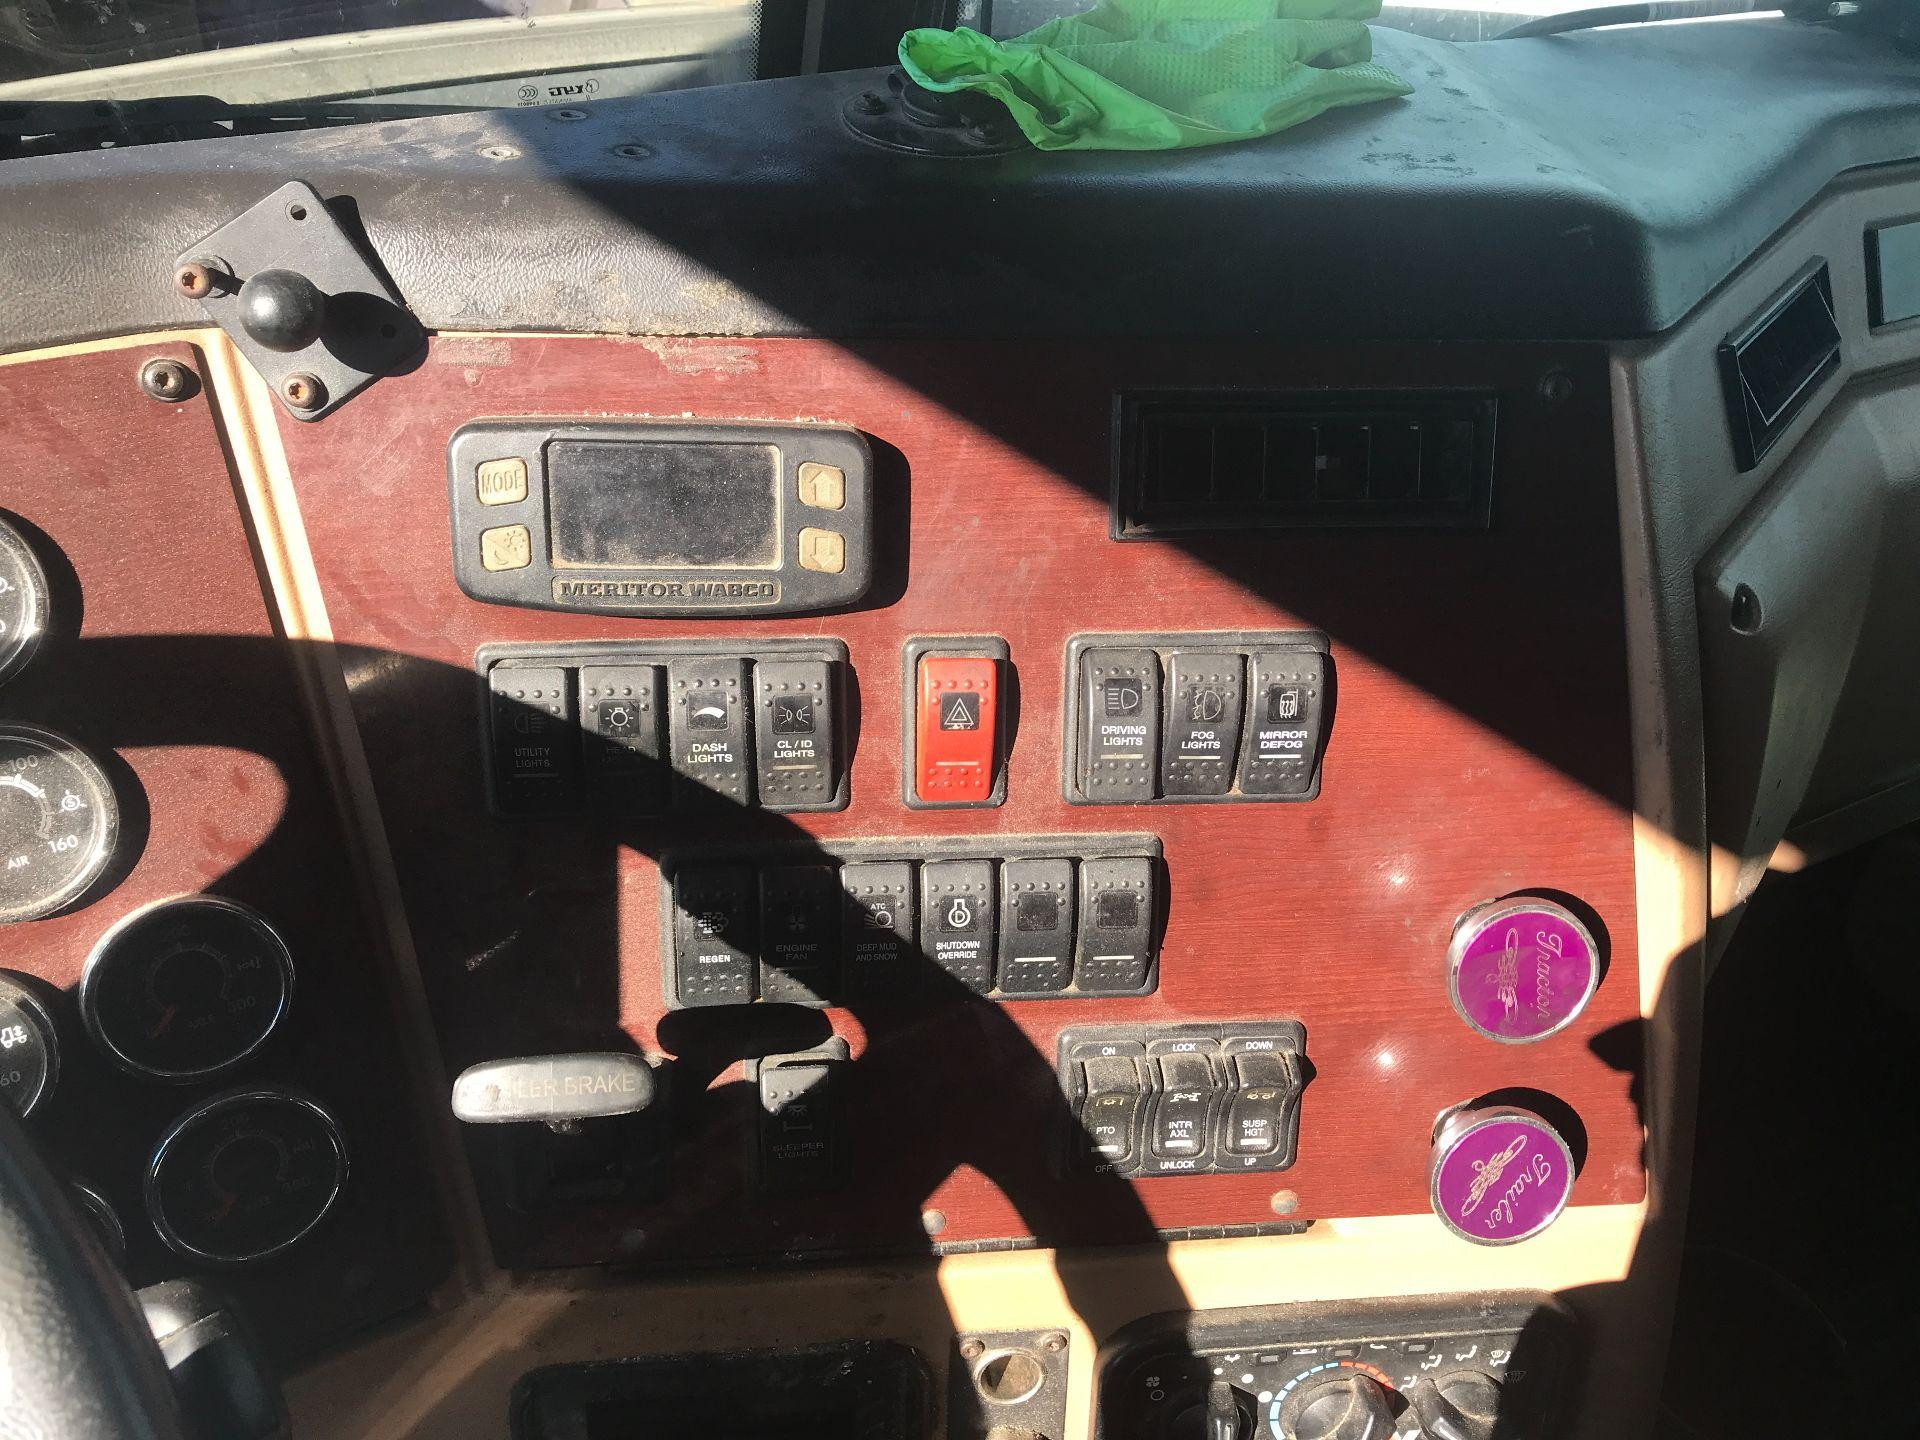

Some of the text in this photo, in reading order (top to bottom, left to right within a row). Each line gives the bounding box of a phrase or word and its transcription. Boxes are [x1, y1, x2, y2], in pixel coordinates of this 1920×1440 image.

[482, 469, 523, 492] MODE
[560, 580, 775, 598] MERITOR WABCO
[1101, 725, 1147, 736] DRIVING
[1190, 730, 1214, 740] FOG
[1259, 730, 1308, 740] MIRROR
[1103, 736, 1143, 746] LIGHTS
[1181, 740, 1221, 749] LIGHTS
[1260, 740, 1303, 749] DEFOG
[514, 747, 551, 757] UTILITY
[692, 742, 727, 752] DASH
[687, 753, 733, 763] LIGHTS
[773, 749, 815, 759] LIGHTS
[515, 759, 551, 768] LIGHTS
[48, 834, 78, 853] 160
[7, 855, 30, 870] AIR
[870, 903, 887, 911] ATC
[775, 943, 818, 953] ENGINE
[856, 942, 898, 952] DEEP MUD
[935, 940, 981, 950] SHUTDOWN
[699, 954, 731, 964] REGEN
[785, 953, 808, 961] FAN
[855, 952, 898, 962] AND SNOW
[937, 950, 978, 960] OVERRIDE
[1535, 930, 1565, 1018] Tractor
[1172, 1042, 1196, 1052] LOCK
[1245, 1040, 1273, 1050] DOWN
[1101, 1046, 1116, 1056] ON
[564, 1072, 636, 1096] BRAKE
[1168, 1120, 1193, 1129] INTR
[1242, 1119, 1267, 1128] SUSP
[1096, 1126, 1115, 1135] PTO
[1169, 1129, 1189, 1138] AXL
[1244, 1128, 1264, 1137] HGT
[1160, 1160, 1195, 1170] UNLOCK
[1244, 1157, 1257, 1166] UP
[1095, 1164, 1112, 1173] OFF
[1484, 1153, 1552, 1230] Trailer
